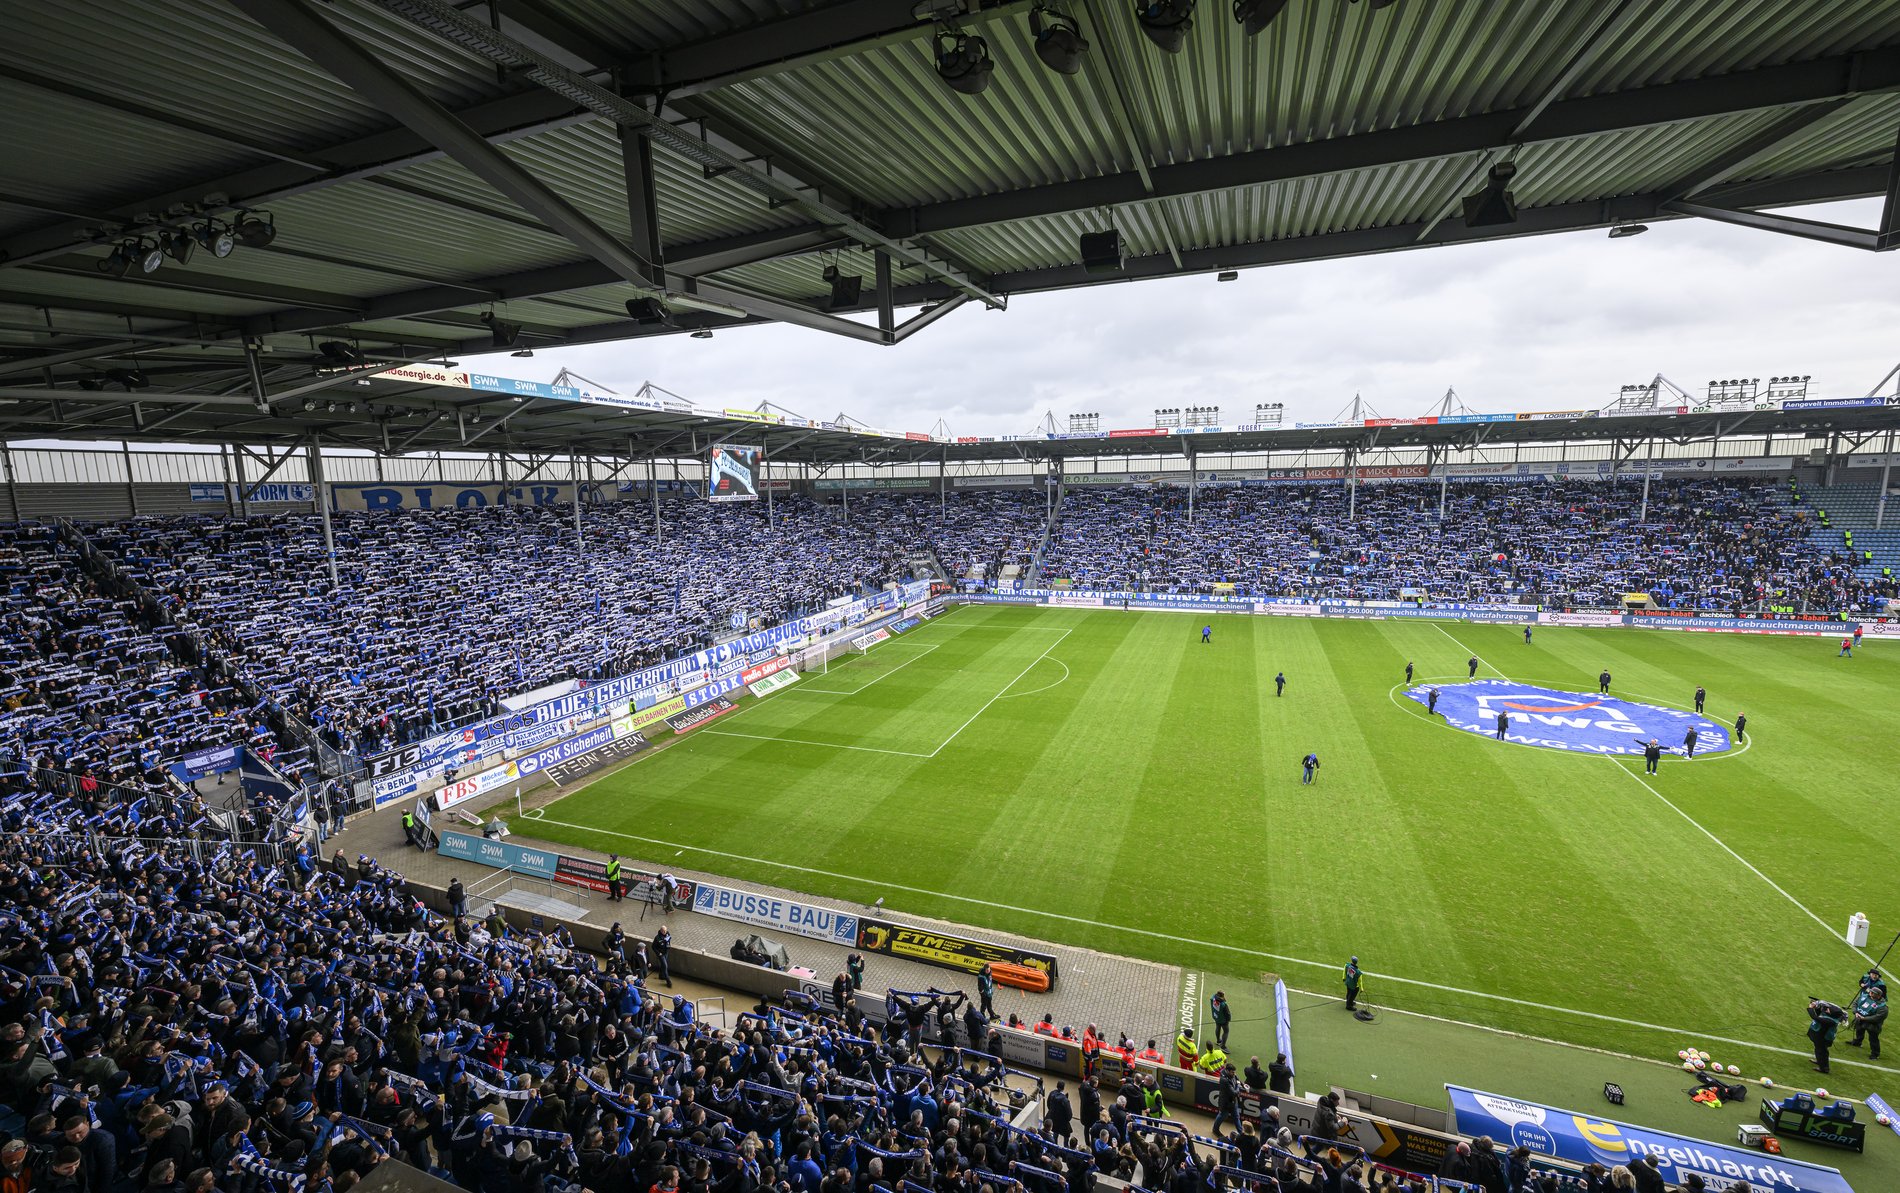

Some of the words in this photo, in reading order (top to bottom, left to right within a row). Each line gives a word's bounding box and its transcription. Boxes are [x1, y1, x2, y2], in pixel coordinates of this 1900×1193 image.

[473, 376, 499, 387] SWM
[514, 381, 538, 392] SWM
[551, 386, 572, 397] SWM
[1177, 601, 1247, 610] Gebrauchtmaschinen!
[1328, 605, 1346, 613] Über
[1375, 607, 1417, 616] gebrauchte
[1470, 610, 1528, 620] Nutzfahrzeuge
[1632, 617, 1649, 625] Der
[1650, 617, 1718, 626] Tabellenführer
[1720, 618, 1735, 627] für
[1737, 620, 1847, 631] Gebrauchtmaschinen!
[705, 645, 728, 665] FC
[728, 619, 806, 659] MAGDEBURG
[743, 670, 762, 684] radio
[761, 662, 778, 675] SAW
[536, 692, 587, 724] BLUE
[597, 659, 691, 705] GENERATION
[689, 674, 738, 706] STORK
[633, 707, 668, 727] SEILBAHNEN
[669, 699, 685, 712] THALE
[674, 699, 732, 730] dachbleche24.de
[1478, 706, 1646, 734] MWG
[539, 746, 562, 768] PSK
[563, 727, 613, 757] Sicherheit
[387, 773, 417, 791] BERLIN
[442, 777, 478, 805] FBS
[446, 836, 468, 850] SWM
[480, 844, 504, 858] SWM
[520, 852, 545, 867] SWM
[719, 891, 781, 919] BUSSE
[789, 905, 830, 930] BAU
[718, 910, 746, 920] INGENIEURBAU
[750, 917, 780, 928] STRASSENBAU
[784, 925, 803, 933] TIEFBAU
[807, 930, 829, 939] HOCHBAU
[897, 931, 946, 949] FTM
[1179, 973, 1197, 1034] www.ktsport.
[1009, 1041, 1039, 1053] Halberstadt
[1487, 1103, 1538, 1119] ATTRAKTIONEN
[1509, 1100, 1528, 1111] 100
[1868, 1095, 1889, 1116] mhkw
[1407, 1133, 1447, 1149] RAUSHOL
[1519, 1130, 1533, 1139] FÜR
[1534, 1134, 1547, 1142] IHR
[1808, 1129, 1858, 1146] SPORT
[1407, 1142, 1425, 1154] WAS
[1523, 1139, 1546, 1151] EVENT
